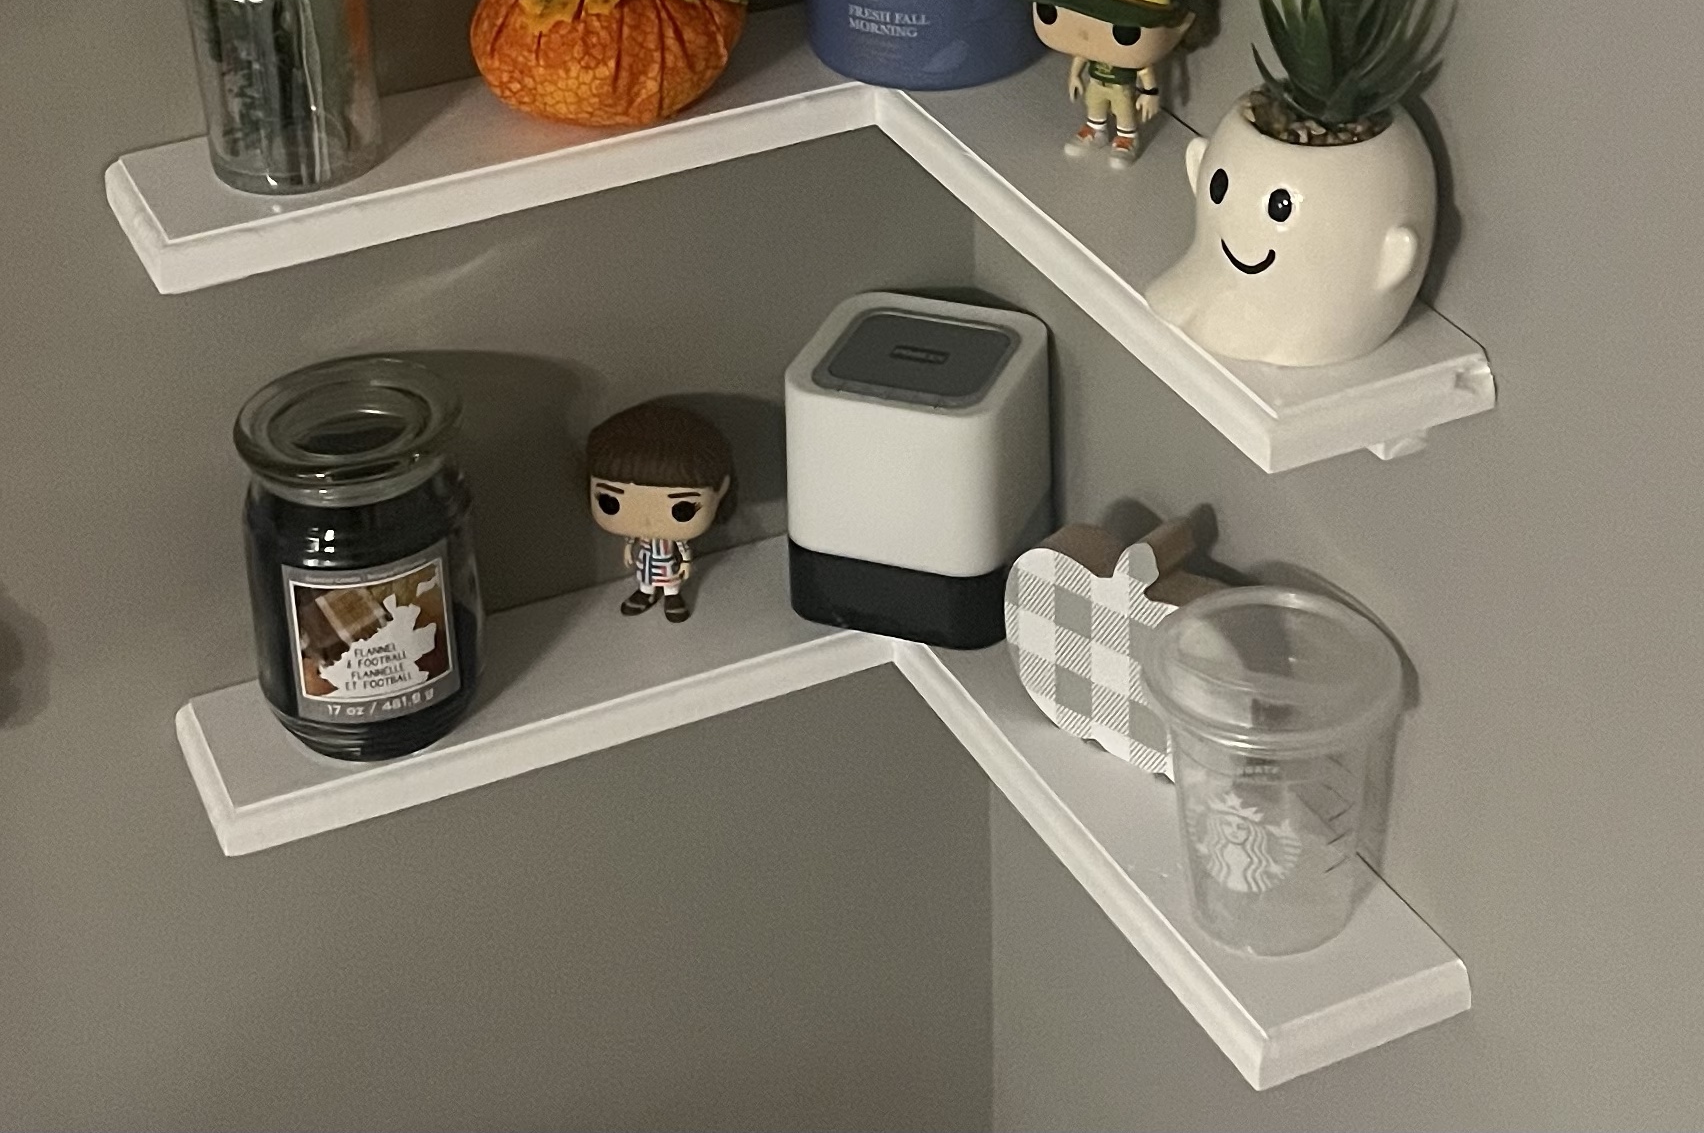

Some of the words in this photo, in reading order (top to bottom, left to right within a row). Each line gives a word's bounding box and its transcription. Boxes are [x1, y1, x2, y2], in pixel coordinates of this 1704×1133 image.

[848, 4, 890, 22] FRESH
[895, 12, 930, 25] FALL
[849, 17, 918, 37] MORNING
[354, 643, 396, 657] FLANNEL
[358, 650, 407, 668] FOOTBALL
[345, 681, 357, 691] ET
[363, 671, 412, 690] FOOTBALL
[327, 704, 341, 715] 17
[346, 706, 364, 716] oz
